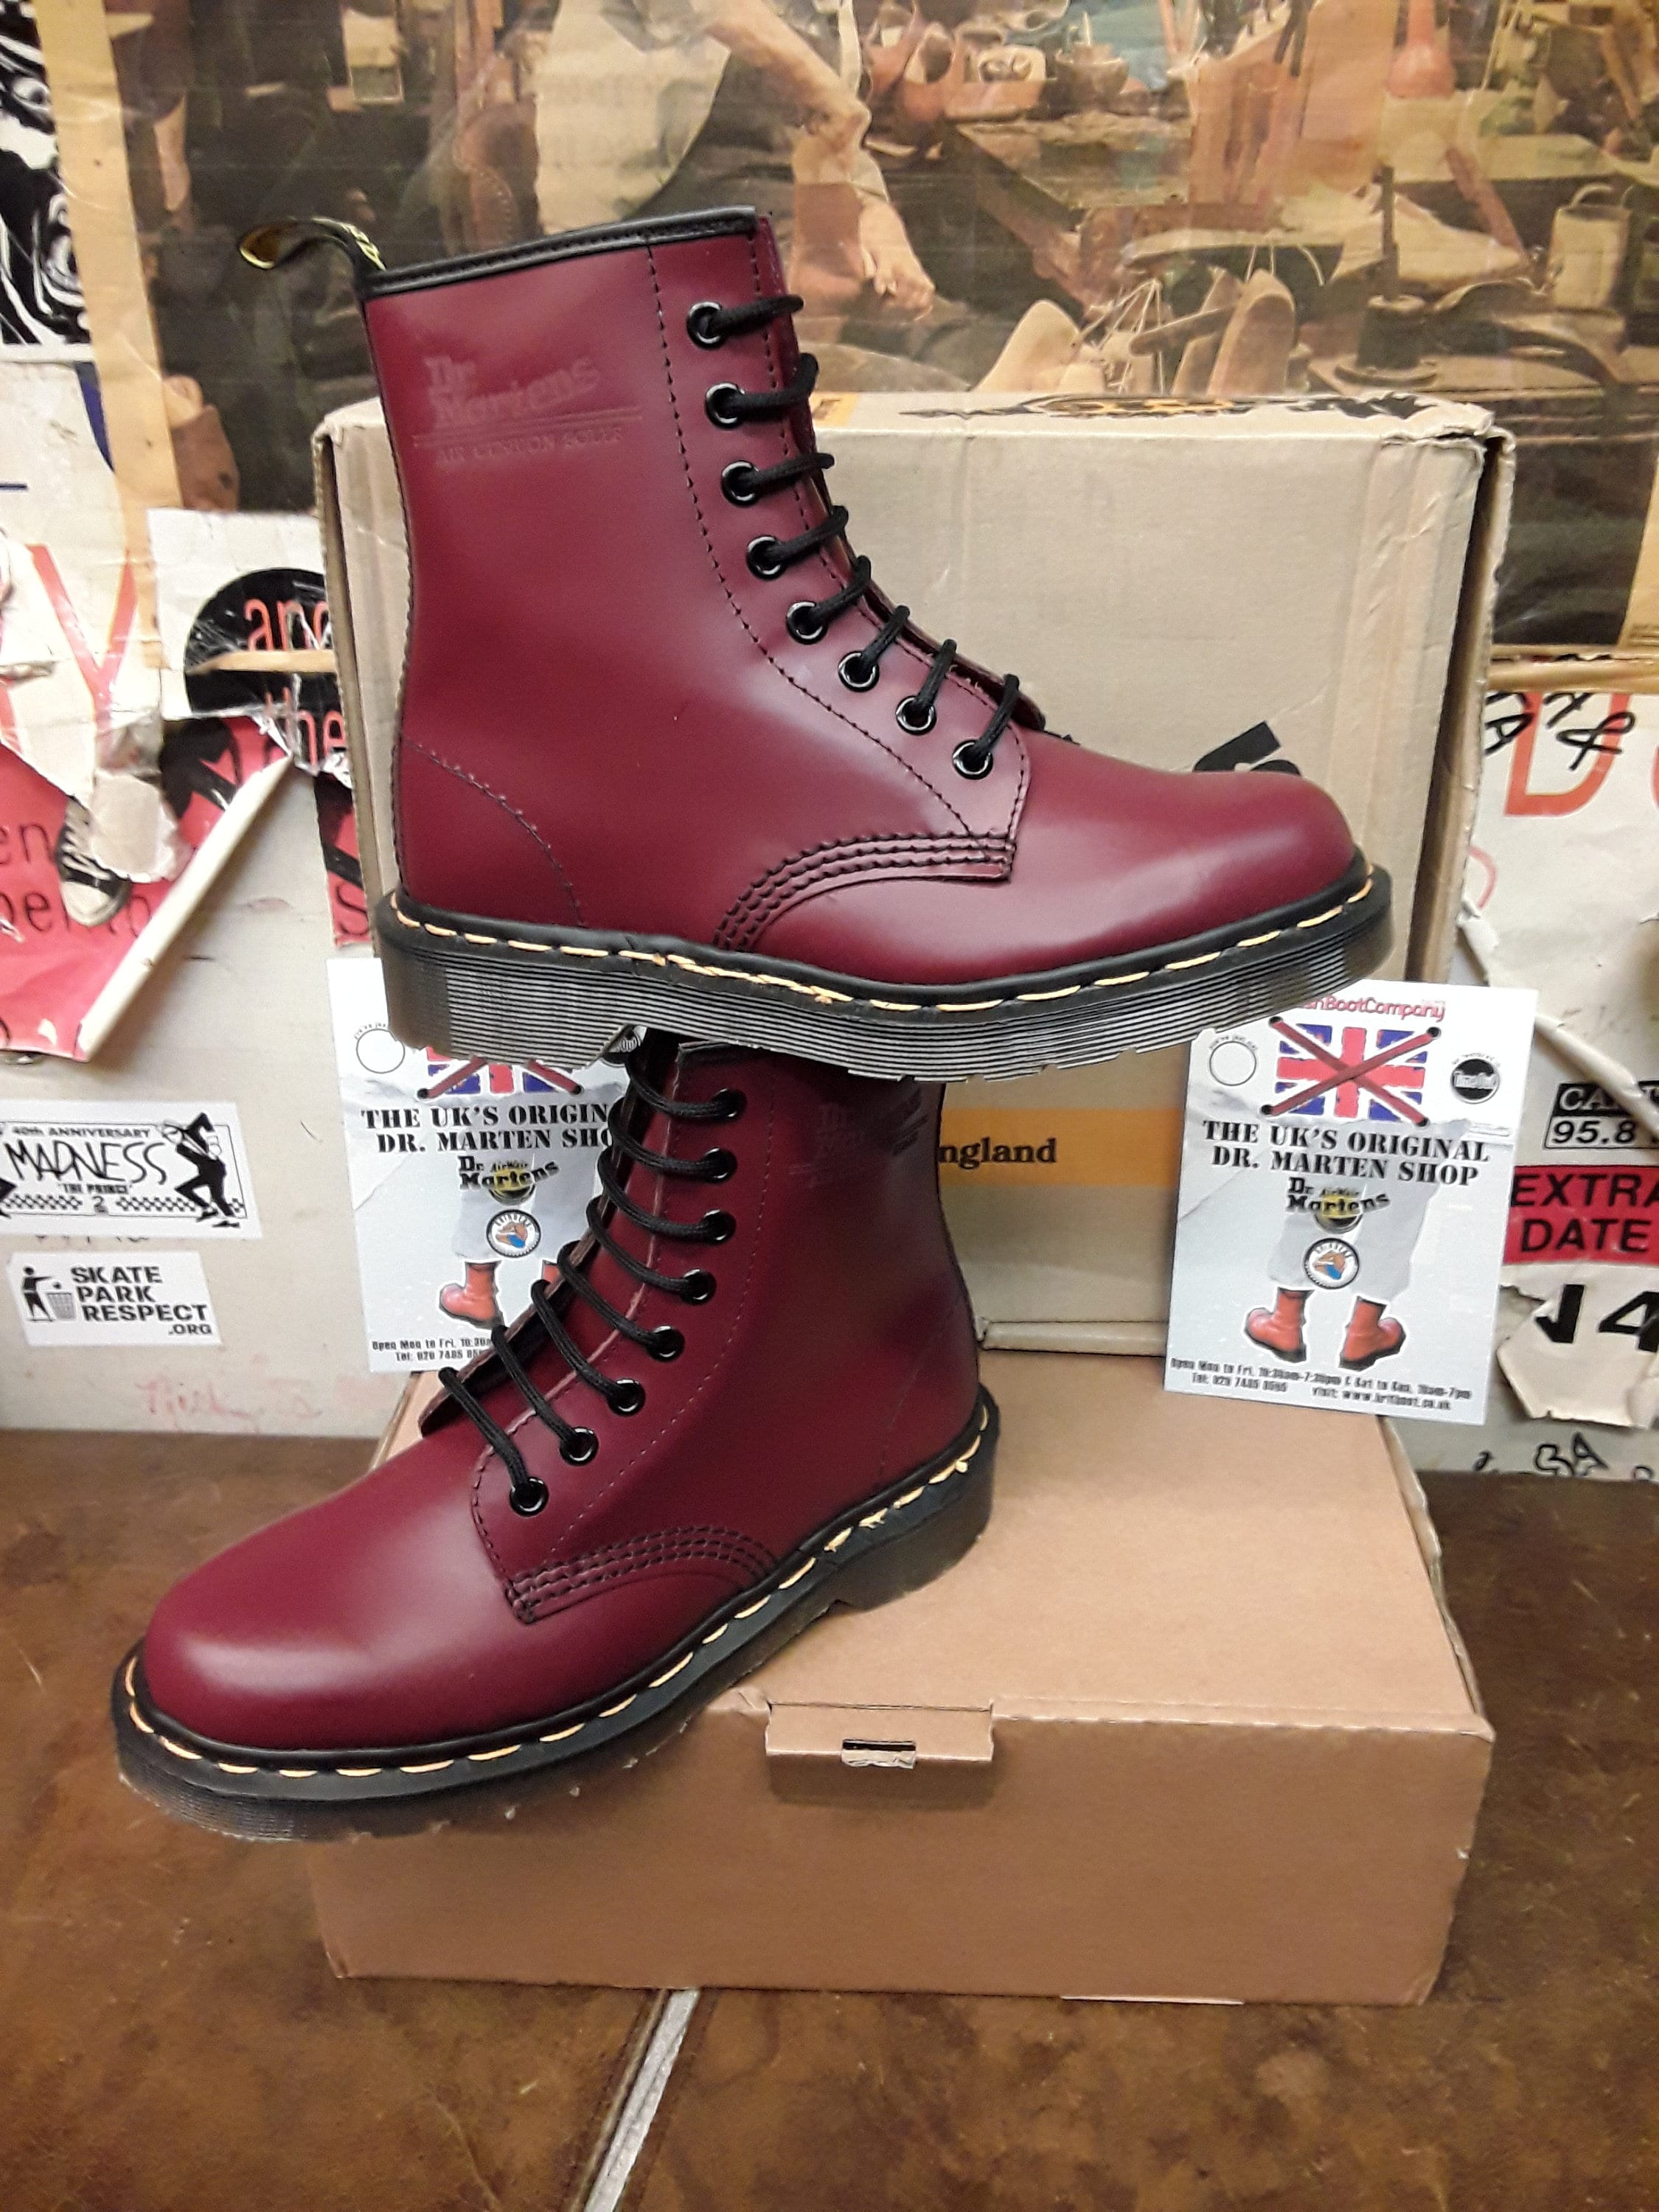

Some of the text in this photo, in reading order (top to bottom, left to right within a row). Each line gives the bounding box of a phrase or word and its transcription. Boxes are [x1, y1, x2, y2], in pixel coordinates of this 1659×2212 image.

[361, 1108, 421, 1129] THE
[509, 1103, 608, 1126] ORIGIN
[48, 1127, 150, 1138] ANNIVERSARY
[377, 1127, 611, 1152] DR. MARTEN SHO
[1203, 1120, 1259, 1144] THE
[1347, 1132, 1490, 1162] ORIGINAL
[1551, 1120, 1636, 1144] 95.8
[5, 1139, 167, 1185] MADNESS
[939, 1136, 1057, 1169] ngland
[1211, 1145, 1478, 1186] DR. MARTEN SHOP
[1521, 1218, 1652, 1252] DATE
[71, 1265, 163, 1284] SKATE
[76, 1286, 156, 1304] PARK
[81, 1304, 208, 1323] RESPECT
[168, 1324, 213, 1335] .ORG
